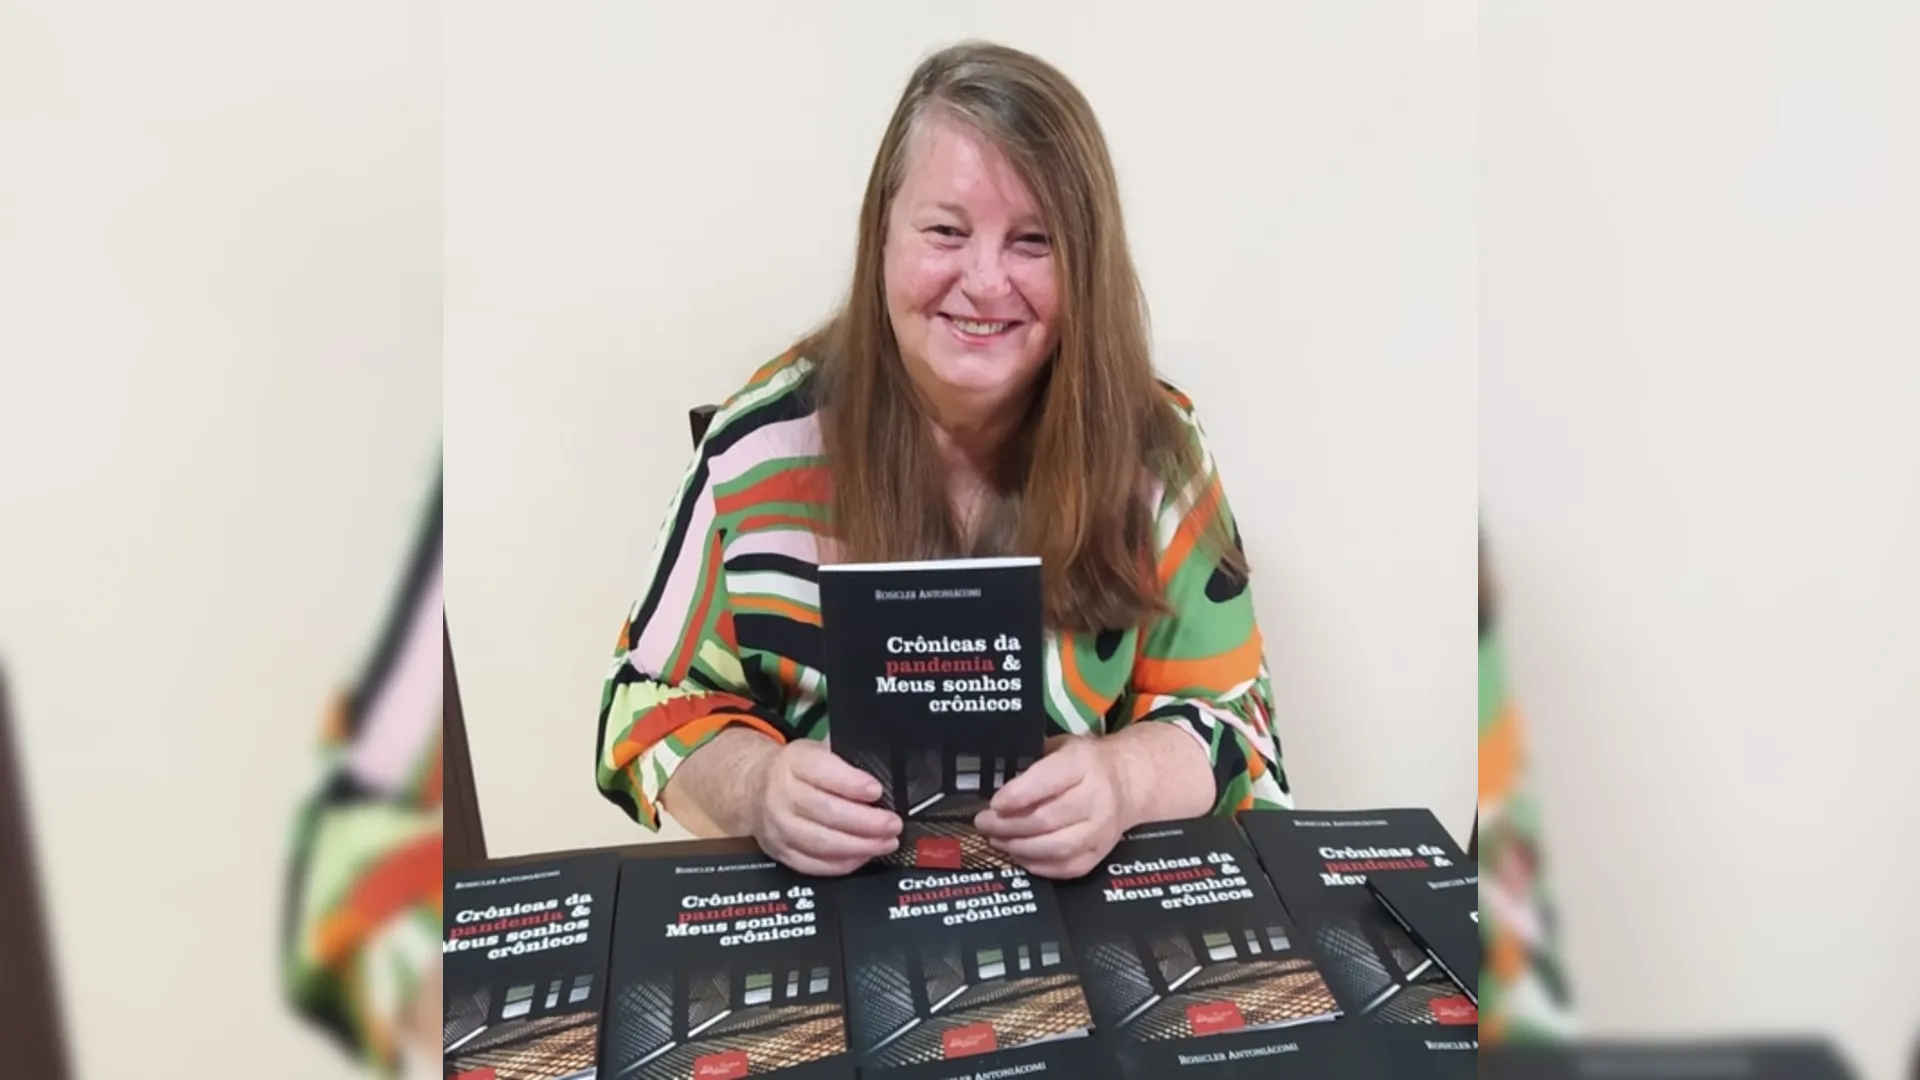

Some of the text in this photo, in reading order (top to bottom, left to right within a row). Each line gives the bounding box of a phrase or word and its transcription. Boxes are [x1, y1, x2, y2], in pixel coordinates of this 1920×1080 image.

[886, 634, 1021, 654] Crônicas da
[885, 654, 1021, 677] pandemia &
[875, 675, 1022, 693] Meus sonhos
[929, 695, 1022, 712] crônicos
[1108, 852, 1235, 875] Crônicas da
[1318, 844, 1445, 860] Crônicas da
[1110, 863, 1240, 889] pandemia &
[1325, 857, 1454, 874] pandemia &
[898, 869, 994, 891] Crônicas
[898, 878, 1030, 905] pandemia &
[1103, 875, 1247, 902] Meus sonhos
[456, 893, 593, 923] Crônicas da
[681, 886, 814, 908] Crônicas da
[889, 890, 1034, 919] Meus sonhos
[1161, 888, 1253, 909] crônicos
[449, 905, 591, 939] pandemia &
[677, 898, 814, 924] pandemia &
[943, 902, 1037, 925] crônicos
[506, 920, 589, 942] sonhos
[665, 911, 816, 938] Meus sonhos
[719, 925, 816, 946] crônicos
[487, 932, 588, 959] crônicos
